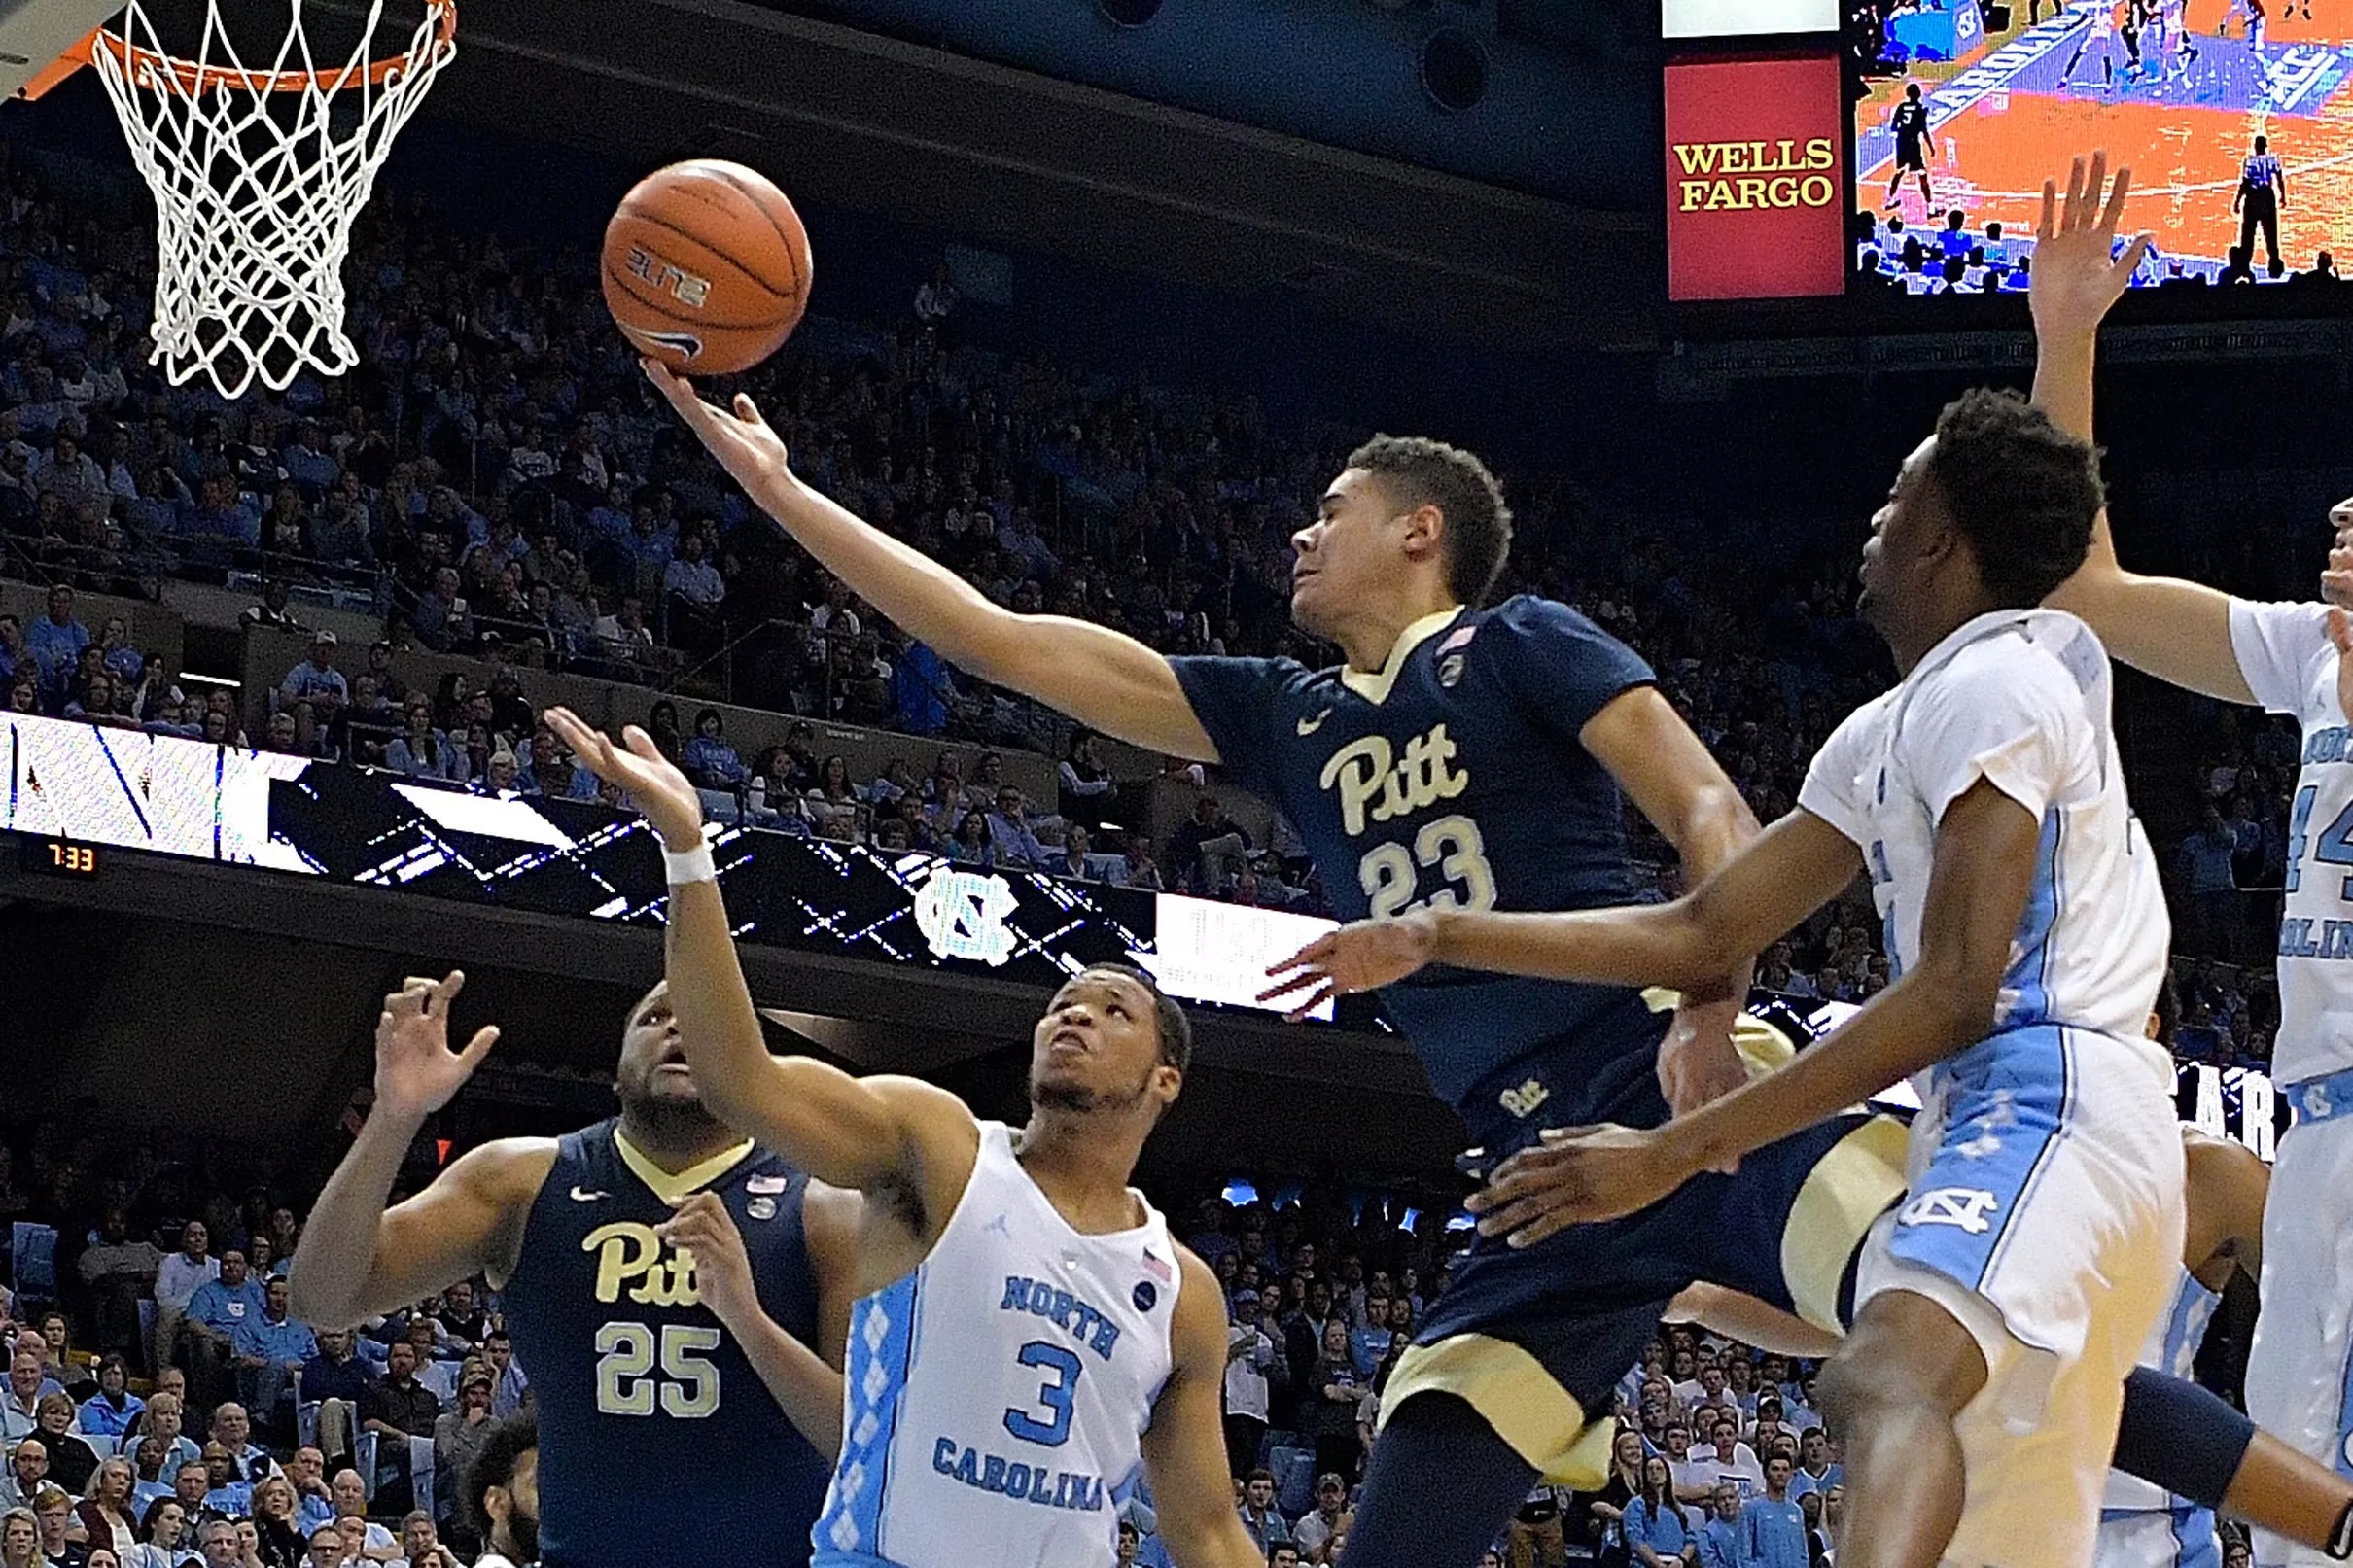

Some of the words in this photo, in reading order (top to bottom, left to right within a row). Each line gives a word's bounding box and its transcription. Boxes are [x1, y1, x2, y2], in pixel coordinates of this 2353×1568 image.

[1673, 139, 1834, 175] WELLS
[1679, 176, 1834, 212] FARGO
[1319, 723, 1469, 836] Pitt
[48, 844, 94, 872] 7:33
[1358, 815, 1497, 923] 23
[581, 1221, 701, 1307] Pit
[1000, 1275, 1121, 1362] NORTH
[594, 1322, 720, 1419] 25
[1002, 1339, 1083, 1447] 3
